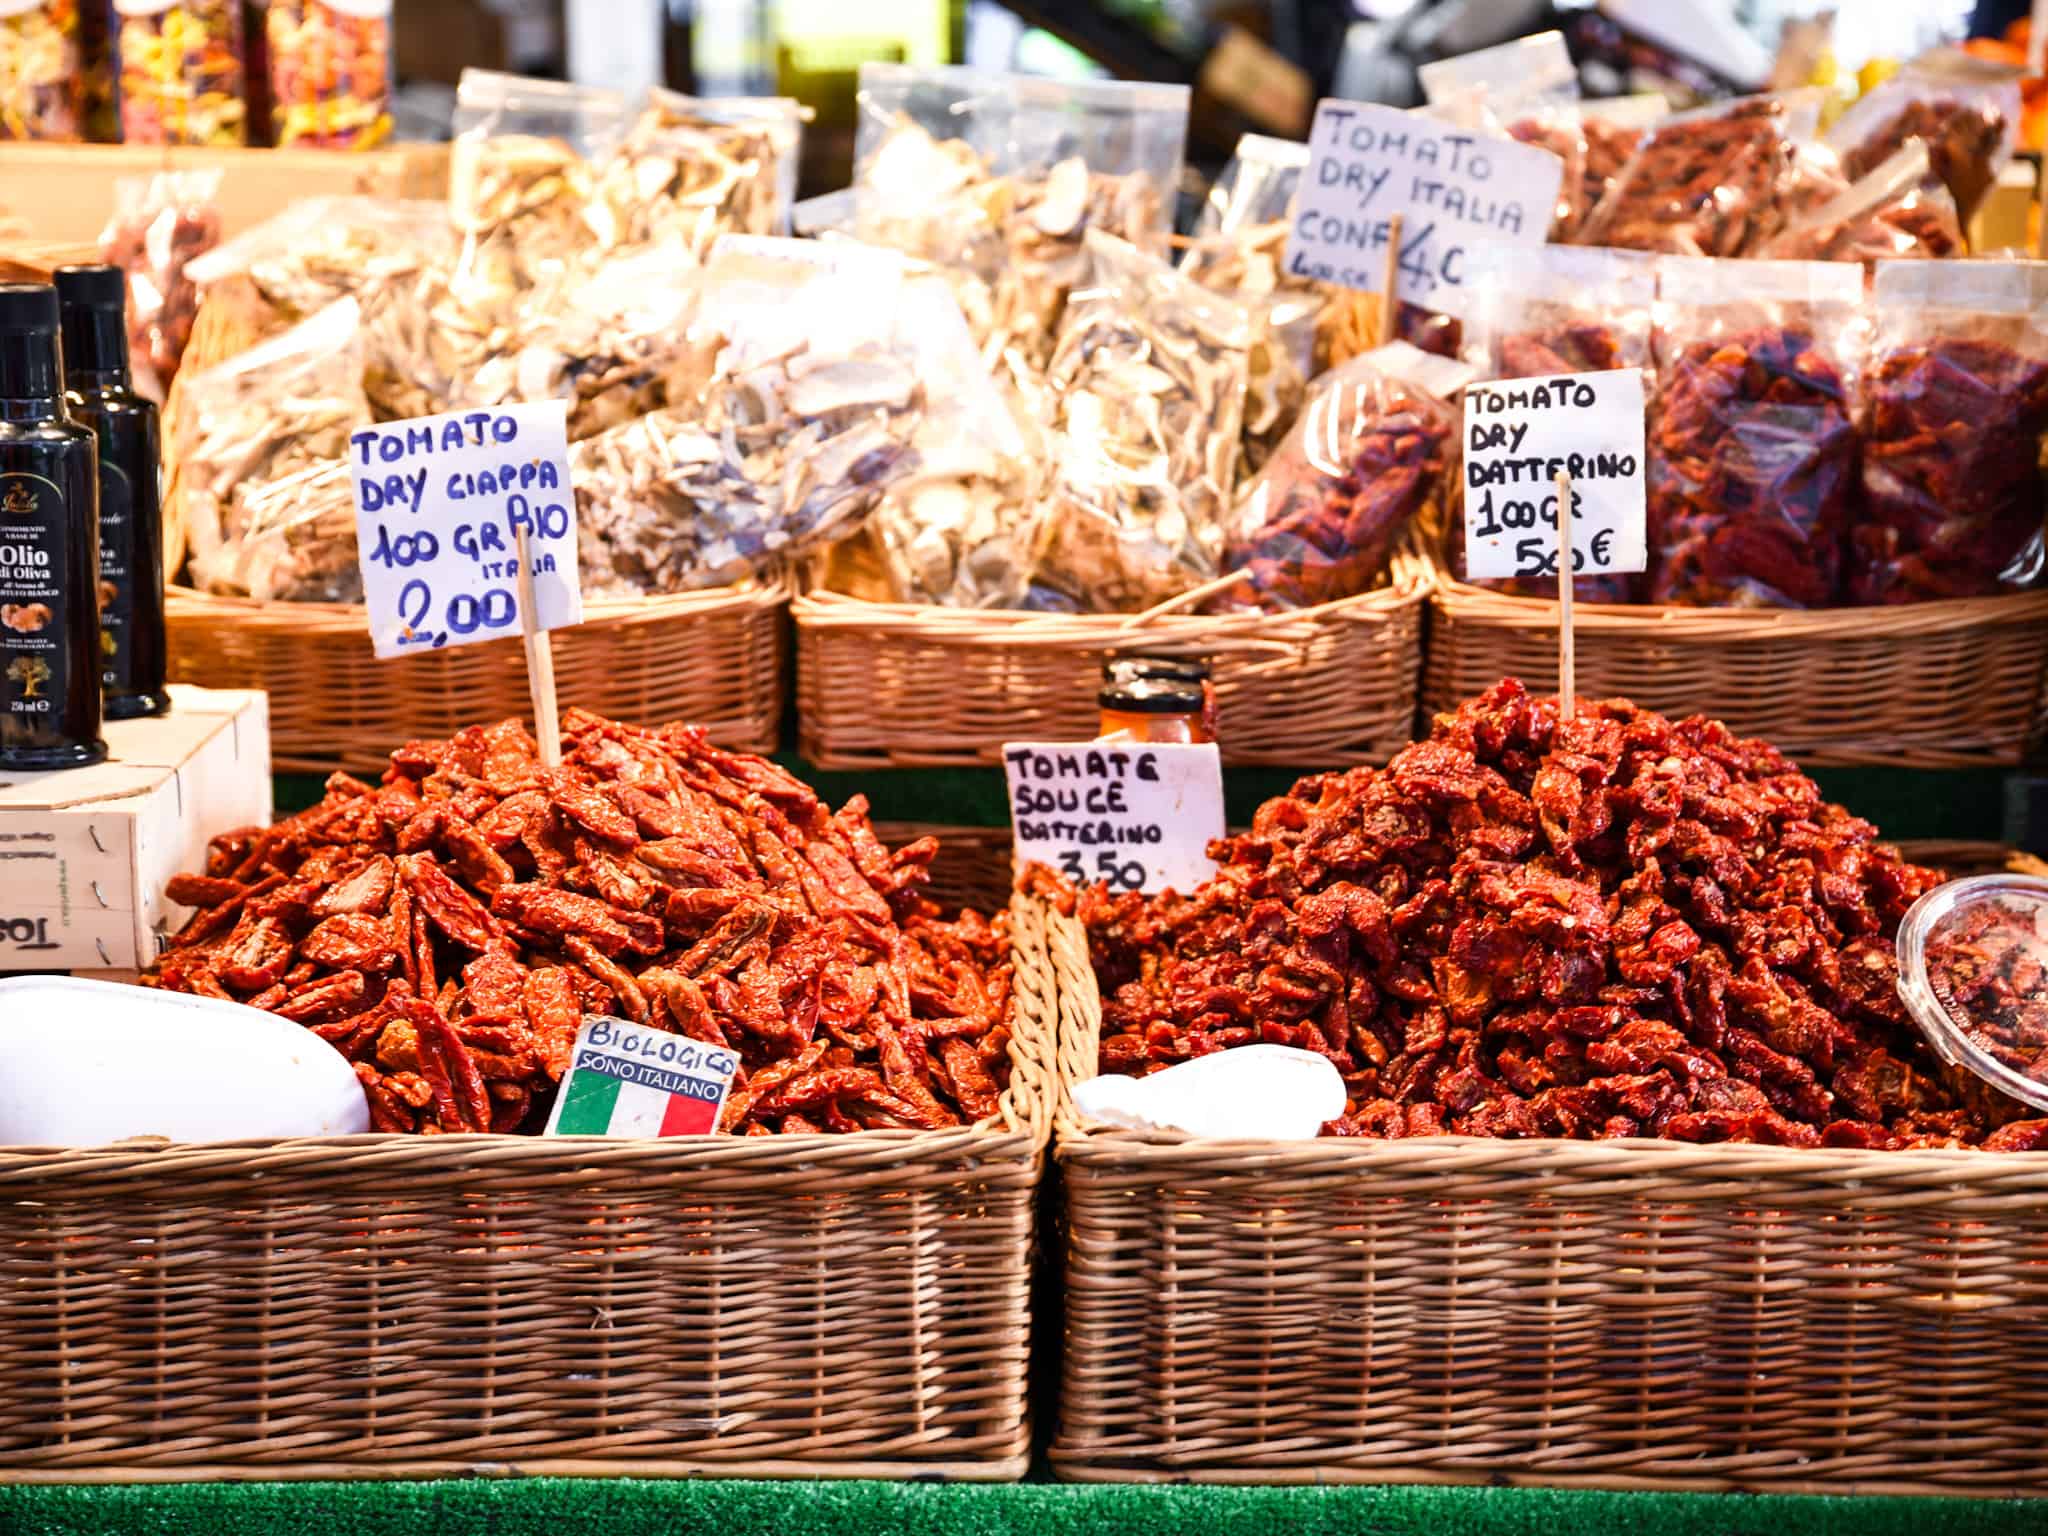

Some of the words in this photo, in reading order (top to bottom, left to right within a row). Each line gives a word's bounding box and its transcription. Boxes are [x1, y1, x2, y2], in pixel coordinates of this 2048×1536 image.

[1322, 108, 1492, 181] TOMATO
[1318, 156, 1391, 210] DRY
[1410, 177, 1524, 236] ITALIA
[1466, 378, 1596, 414] TOMATO
[351, 412, 518, 465] TOMATO
[1470, 422, 1529, 454] DRY
[360, 467, 428, 513] DRY
[446, 460, 559, 500] CIAPPA
[1468, 452, 1636, 488] DATTERINO
[370, 524, 440, 569] 100
[453, 522, 506, 562] GR
[507, 494, 569, 540] BIO
[0, 545, 48, 567] Olio
[13, 567, 51, 580] Oliva
[482, 553, 556, 580] ITAIA
[397, 579, 518, 648] 2,00
[1016, 781, 1128, 815] SOUCE
[1018, 820, 1163, 845] DATTERINO
[587, 1021, 736, 1076] BIOLOGICO
[576, 1053, 636, 1079] SONO
[637, 1066, 720, 1101] ITALIANO
